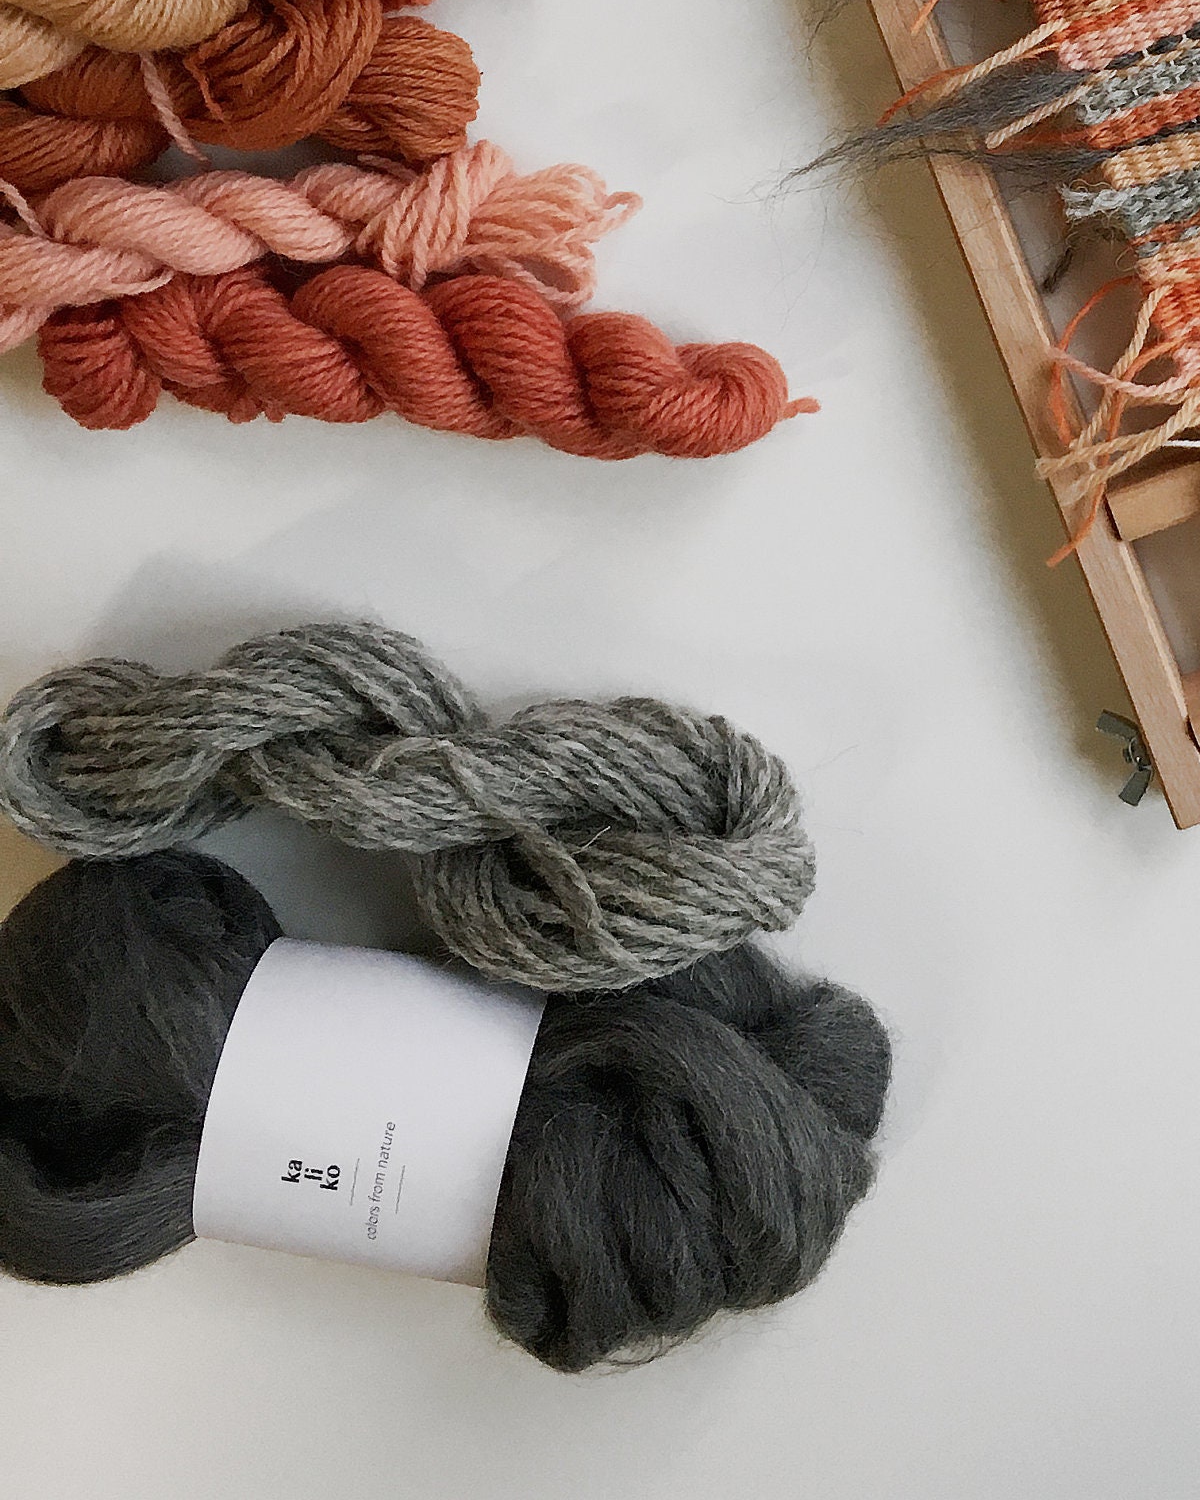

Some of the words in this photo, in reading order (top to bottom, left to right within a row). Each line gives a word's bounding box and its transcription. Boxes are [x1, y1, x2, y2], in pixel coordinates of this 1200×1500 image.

[378, 1121, 396, 1169] nature
[281, 1159, 303, 1183] ka
[304, 1168, 324, 1181] li
[320, 1164, 341, 1191] ko
[368, 1172, 386, 1203] from
[366, 1205, 380, 1241] colors
